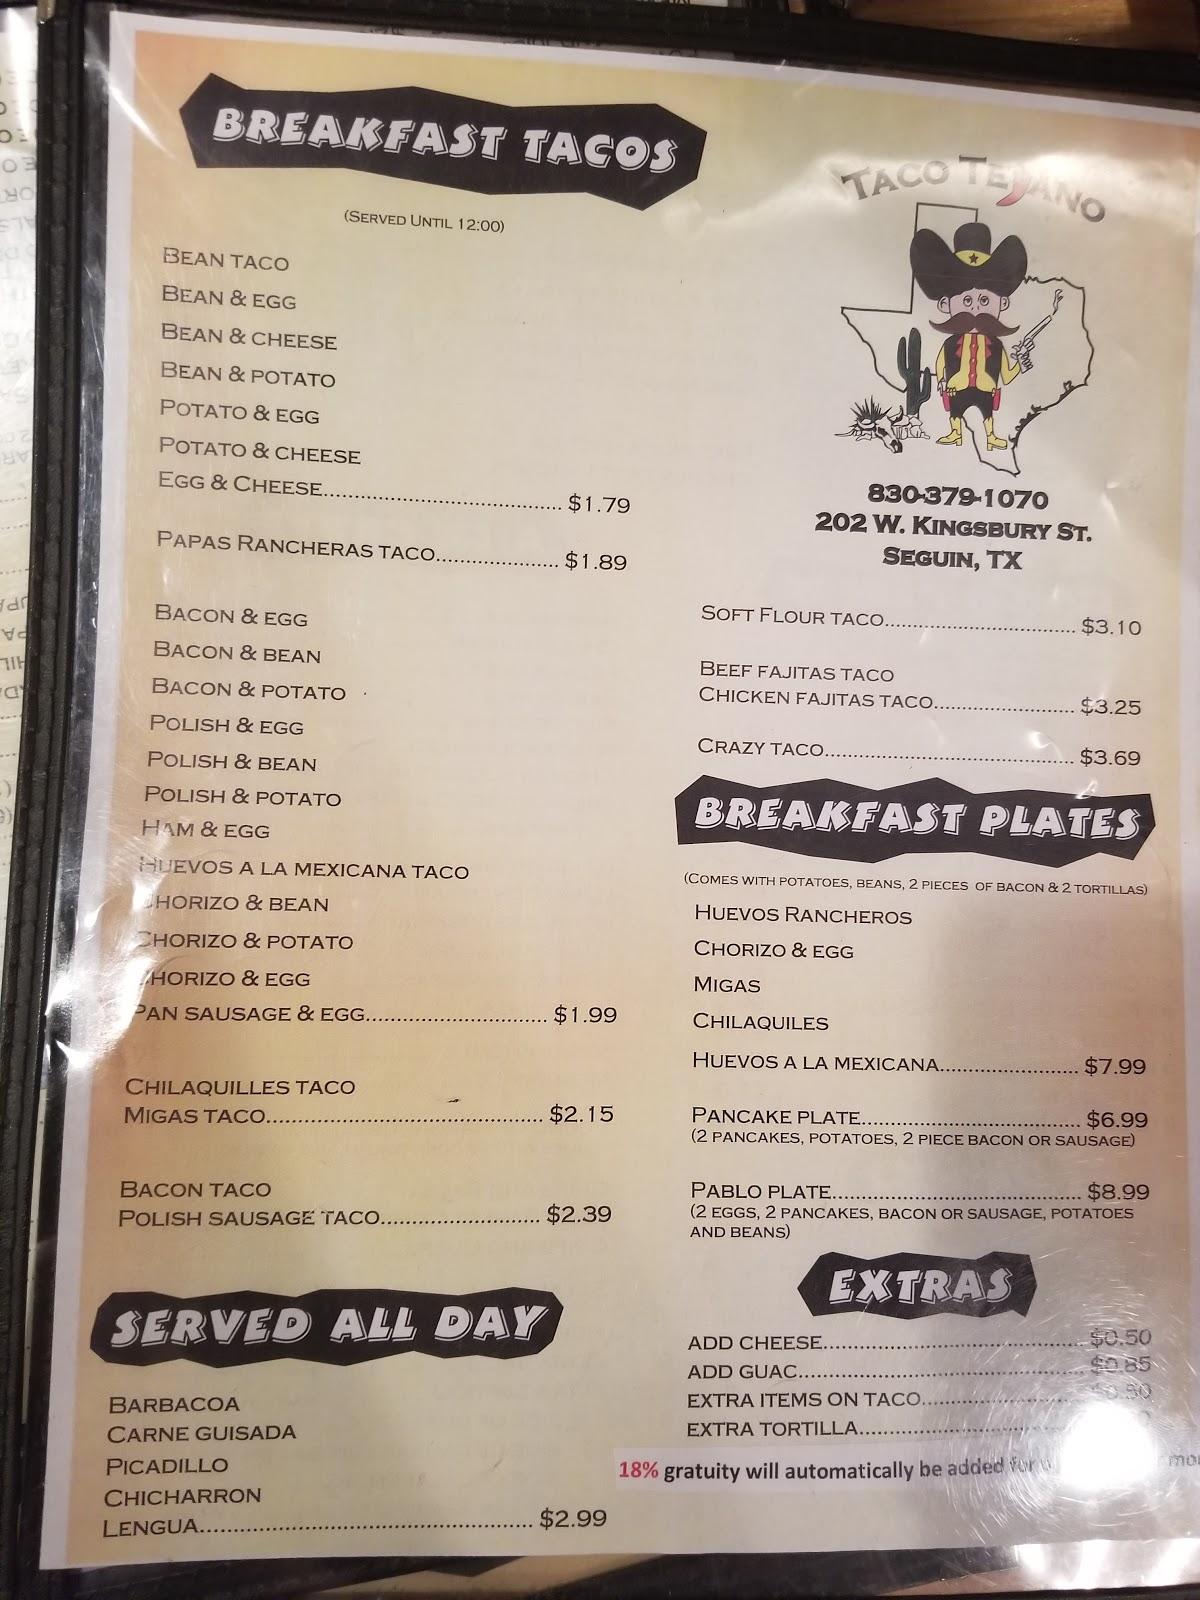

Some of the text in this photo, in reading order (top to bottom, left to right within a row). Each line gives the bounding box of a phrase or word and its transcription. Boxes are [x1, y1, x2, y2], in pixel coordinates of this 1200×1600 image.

[212, 107, 678, 173] BREAKFAST TACOS
[840, 160, 949, 200] TACO
[344, 209, 504, 233] (SERVED UNTIL 12:00)
[163, 247, 289, 271] BEAN TACO
[162, 285, 296, 310] BEAN EGG
[162, 323, 337, 350] BEAN CHEESE
[161, 362, 336, 388] BEAN POTATO
[161, 399, 319, 424] POTATO EGG
[160, 437, 361, 464] POTATO CHEESE
[159, 471, 630, 514] EGG $1.79
[868, 483, 1049, 510] 830-379-1070
[815, 512, 1092, 542] 202 W. KINGSBURY ST.
[158, 531, 627, 571] PAPAS RANCHERAS $1.89
[882, 546, 1023, 572] SEGUIN, TX
[156, 604, 308, 627] BACON EGG
[701, 605, 1141, 636] SOFT FLOUR $3.10
[154, 641, 320, 664] BACON BEAN
[701, 661, 894, 682] BEEF FAJITAS TACO
[152, 678, 346, 701] BACON POTATO
[699, 686, 1141, 716] CHICKEN FAJITAS $3.25
[150, 715, 304, 735] POLISH EGG
[148, 751, 316, 772] POLISH BEAN
[698, 738, 1141, 767] CRAZY $3.69
[145, 786, 341, 807] POLISH POTATO
[142, 819, 270, 839] HAM EGG
[695, 797, 1140, 840] BREAKFAST PLATES
[261, 862, 288, 877] LA
[295, 863, 407, 879] MEXICANA
[411, 864, 470, 880] TACO
[684, 872, 1148, 896] (COMES WITH POTATOES, BEANS, 2 PIECES OF BACON & 2 TORTILLAS)
[269, 898, 328, 912] BEAN
[696, 904, 912, 925] HUEVOS RANCHEROS
[267, 935, 353, 950] POTATO
[694, 940, 853, 959] CHORIZO & EGG
[265, 972, 310, 987] EGG
[694, 976, 760, 993] MIGAS
[185, 1004, 617, 1025] SAUSAGE & $1.99
[693, 1012, 829, 1031] CHILAQUILES
[693, 1052, 778, 1069] HUEVOS
[784, 1056, 797, 1069] A
[803, 1057, 828, 1070] LA
[1084, 1056, 1146, 1077] $7.99
[126, 1078, 355, 1096] CHILAQUILLES TACO
[125, 1103, 613, 1125] MIGAS $2.15
[693, 1107, 1148, 1130] PANCAKE $6.99
[692, 1128, 1135, 1147] (2 PANCAKES, POTATOES, 2 PIECE BACON OR SAUSAGE)
[121, 1181, 271, 1198] BACON TACO
[692, 1182, 1150, 1202] PABLO $8.99
[119, 1203, 611, 1227] POLISH SAUSAGE $2.39
[691, 1203, 1134, 1221] (2 EGGS, 2 PANCAKES, BACON OR SAUSAGE, POTATOES
[690, 1224, 790, 1239] AND BEANS)
[829, 1268, 1013, 1304] EXTRAS
[111, 1305, 549, 1348] SERVED ALL DAY
[688, 1328, 1152, 1350] ADD $0.50
[688, 1365, 733, 1379] ADD
[109, 1397, 240, 1414] BARBACOA
[688, 1392, 858, 1408] EXTRA ITEMS ON
[107, 1425, 297, 1443] CARNE GUISADA
[687, 1422, 754, 1437] EXTRA
[106, 1458, 228, 1476] PICADILLO
[620, 1462, 658, 1478] 18%
[664, 1462, 740, 1483] gratuity
[746, 1462, 778, 1479] will
[785, 1461, 914, 1482] automatically
[920, 1460, 942, 1477] be
[948, 1457, 1004, 1476] added
[104, 1488, 261, 1507] CHICHARRON
[540, 1507, 607, 1531] $2.99
